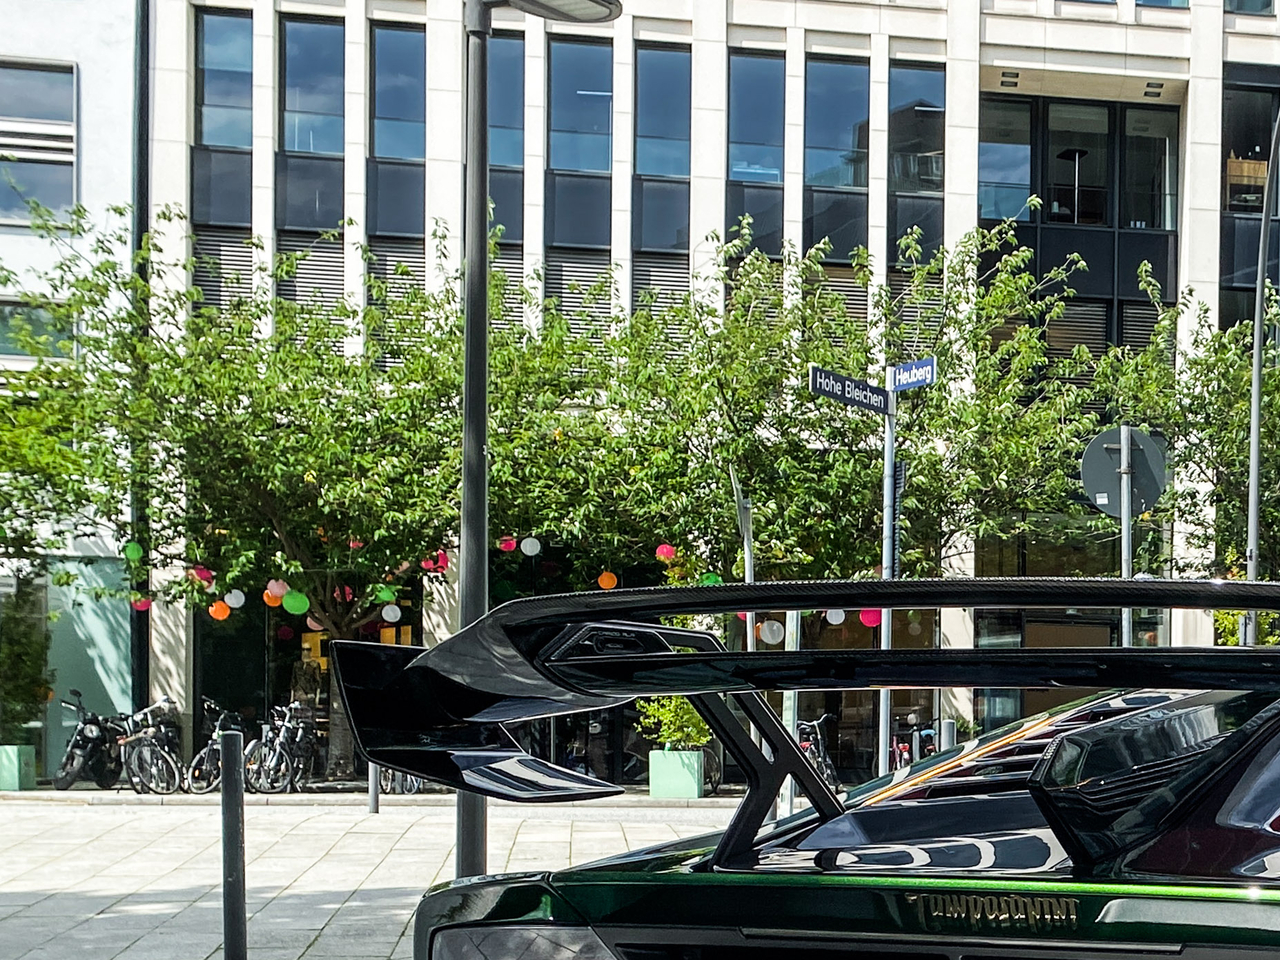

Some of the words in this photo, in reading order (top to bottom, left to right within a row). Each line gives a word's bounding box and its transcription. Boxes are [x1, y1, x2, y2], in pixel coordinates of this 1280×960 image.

[895, 365, 932, 385] Heuberg
[816, 371, 842, 394] Hohe
[845, 380, 884, 408] Bleichen
